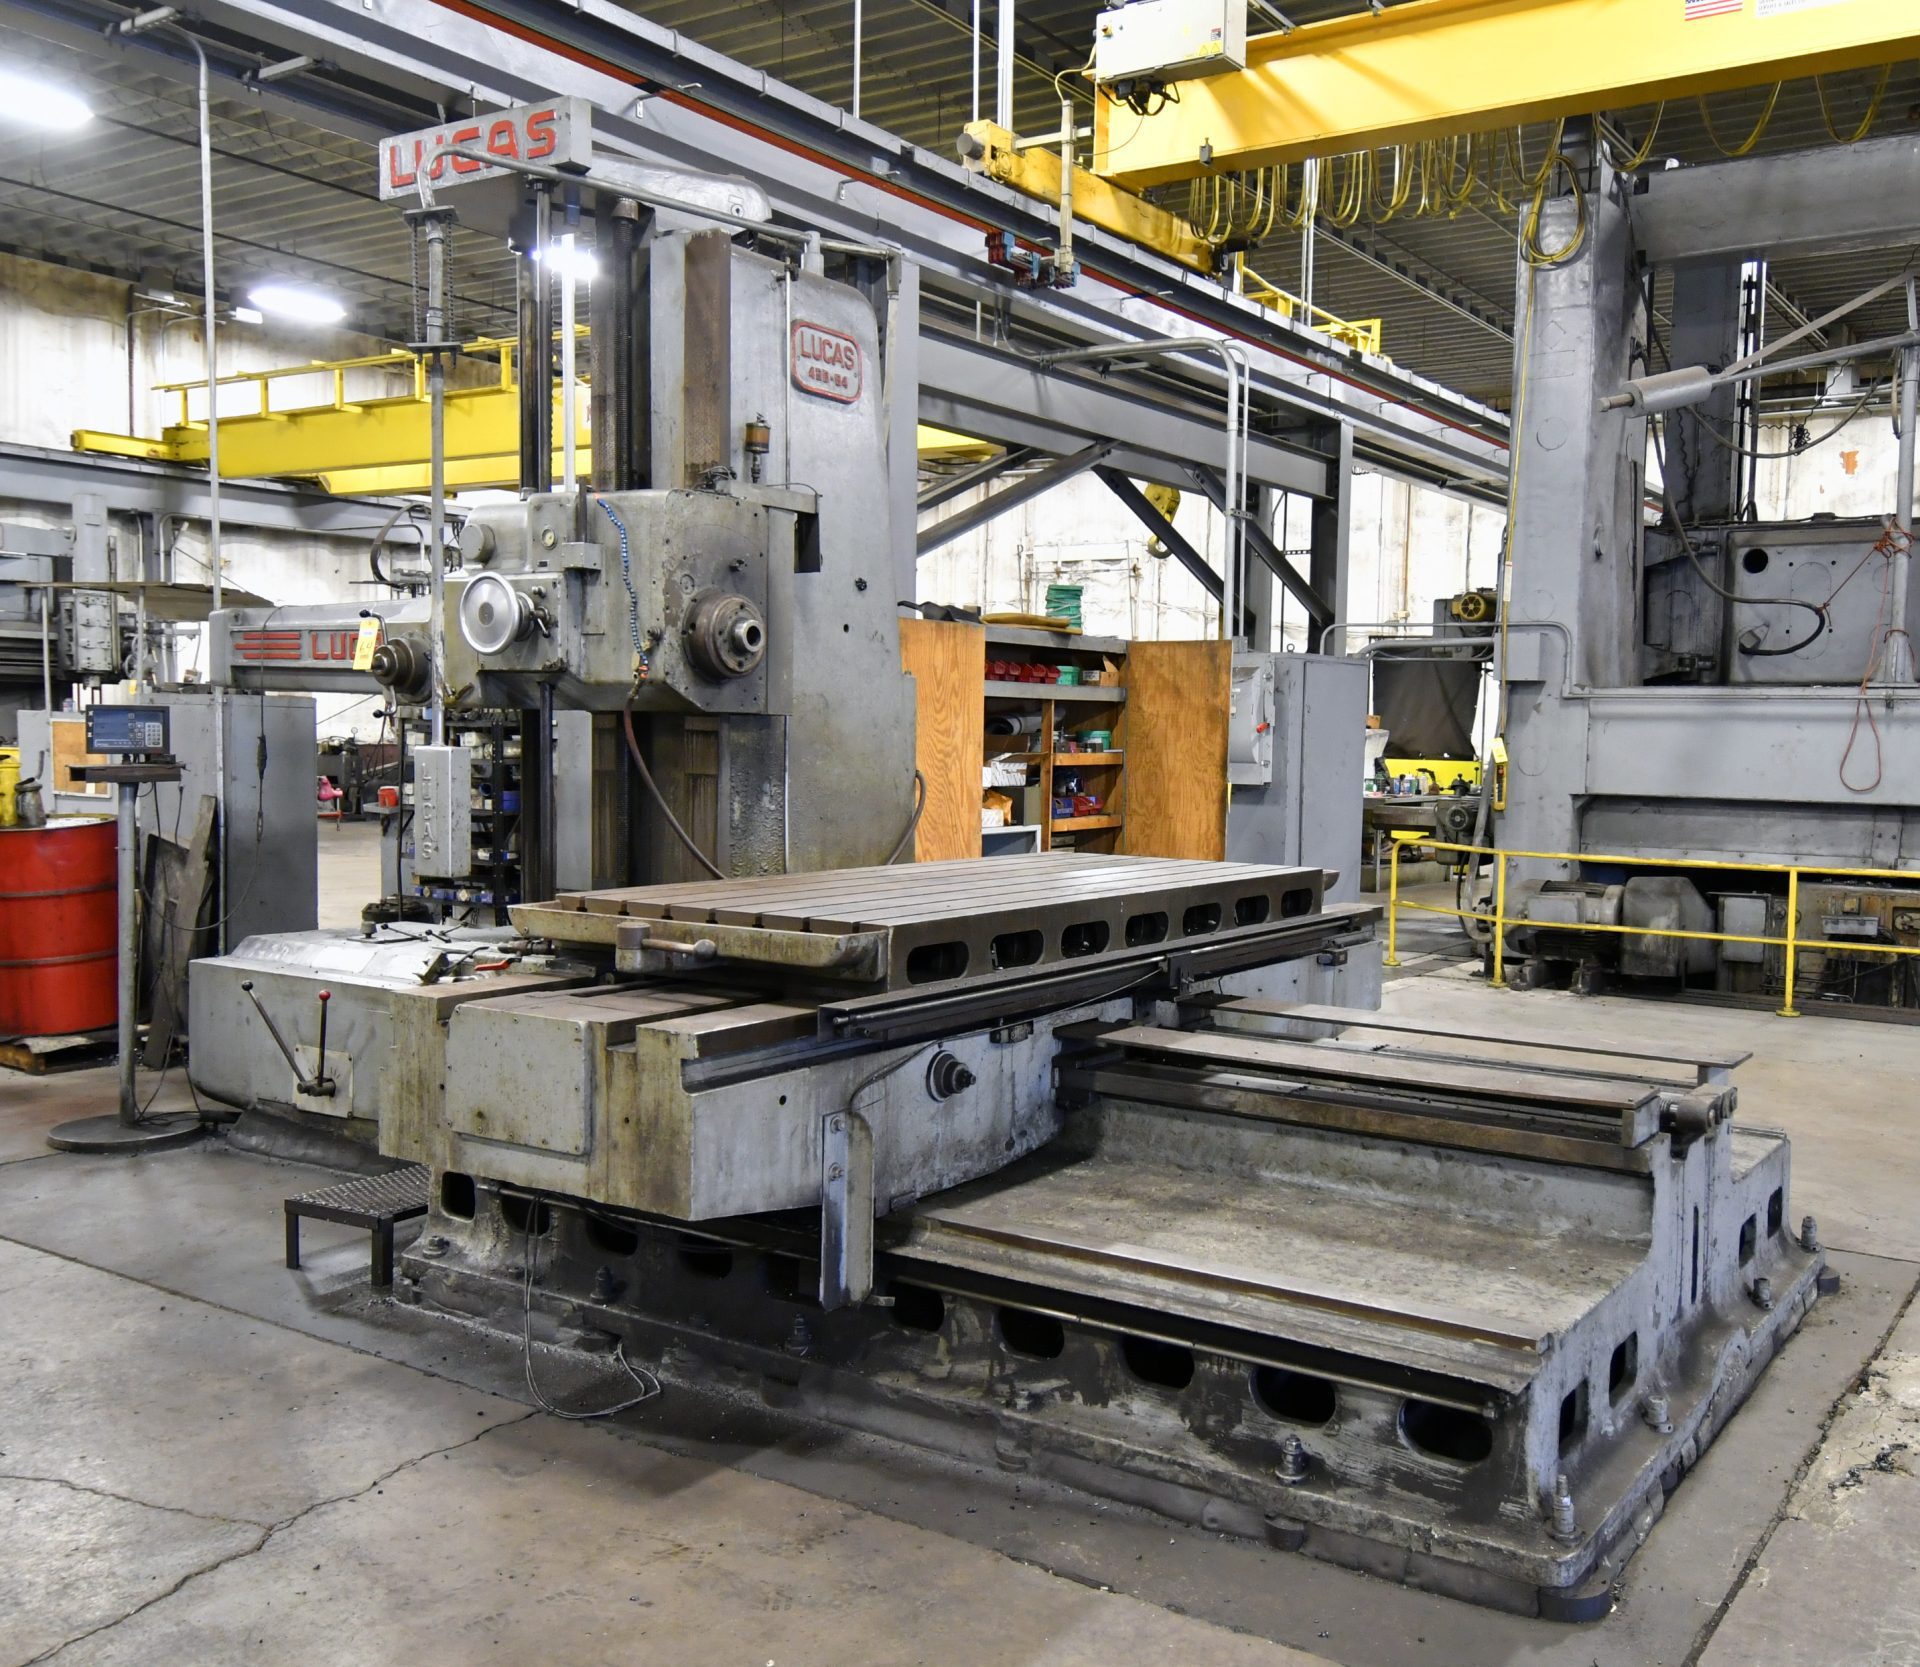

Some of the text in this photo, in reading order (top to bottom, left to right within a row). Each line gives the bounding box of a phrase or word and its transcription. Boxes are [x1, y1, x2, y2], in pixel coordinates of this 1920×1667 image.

[389, 108, 557, 188] LUCAS
[801, 331, 854, 370] LUCAS
[421, 761, 435, 860] LUCAS
